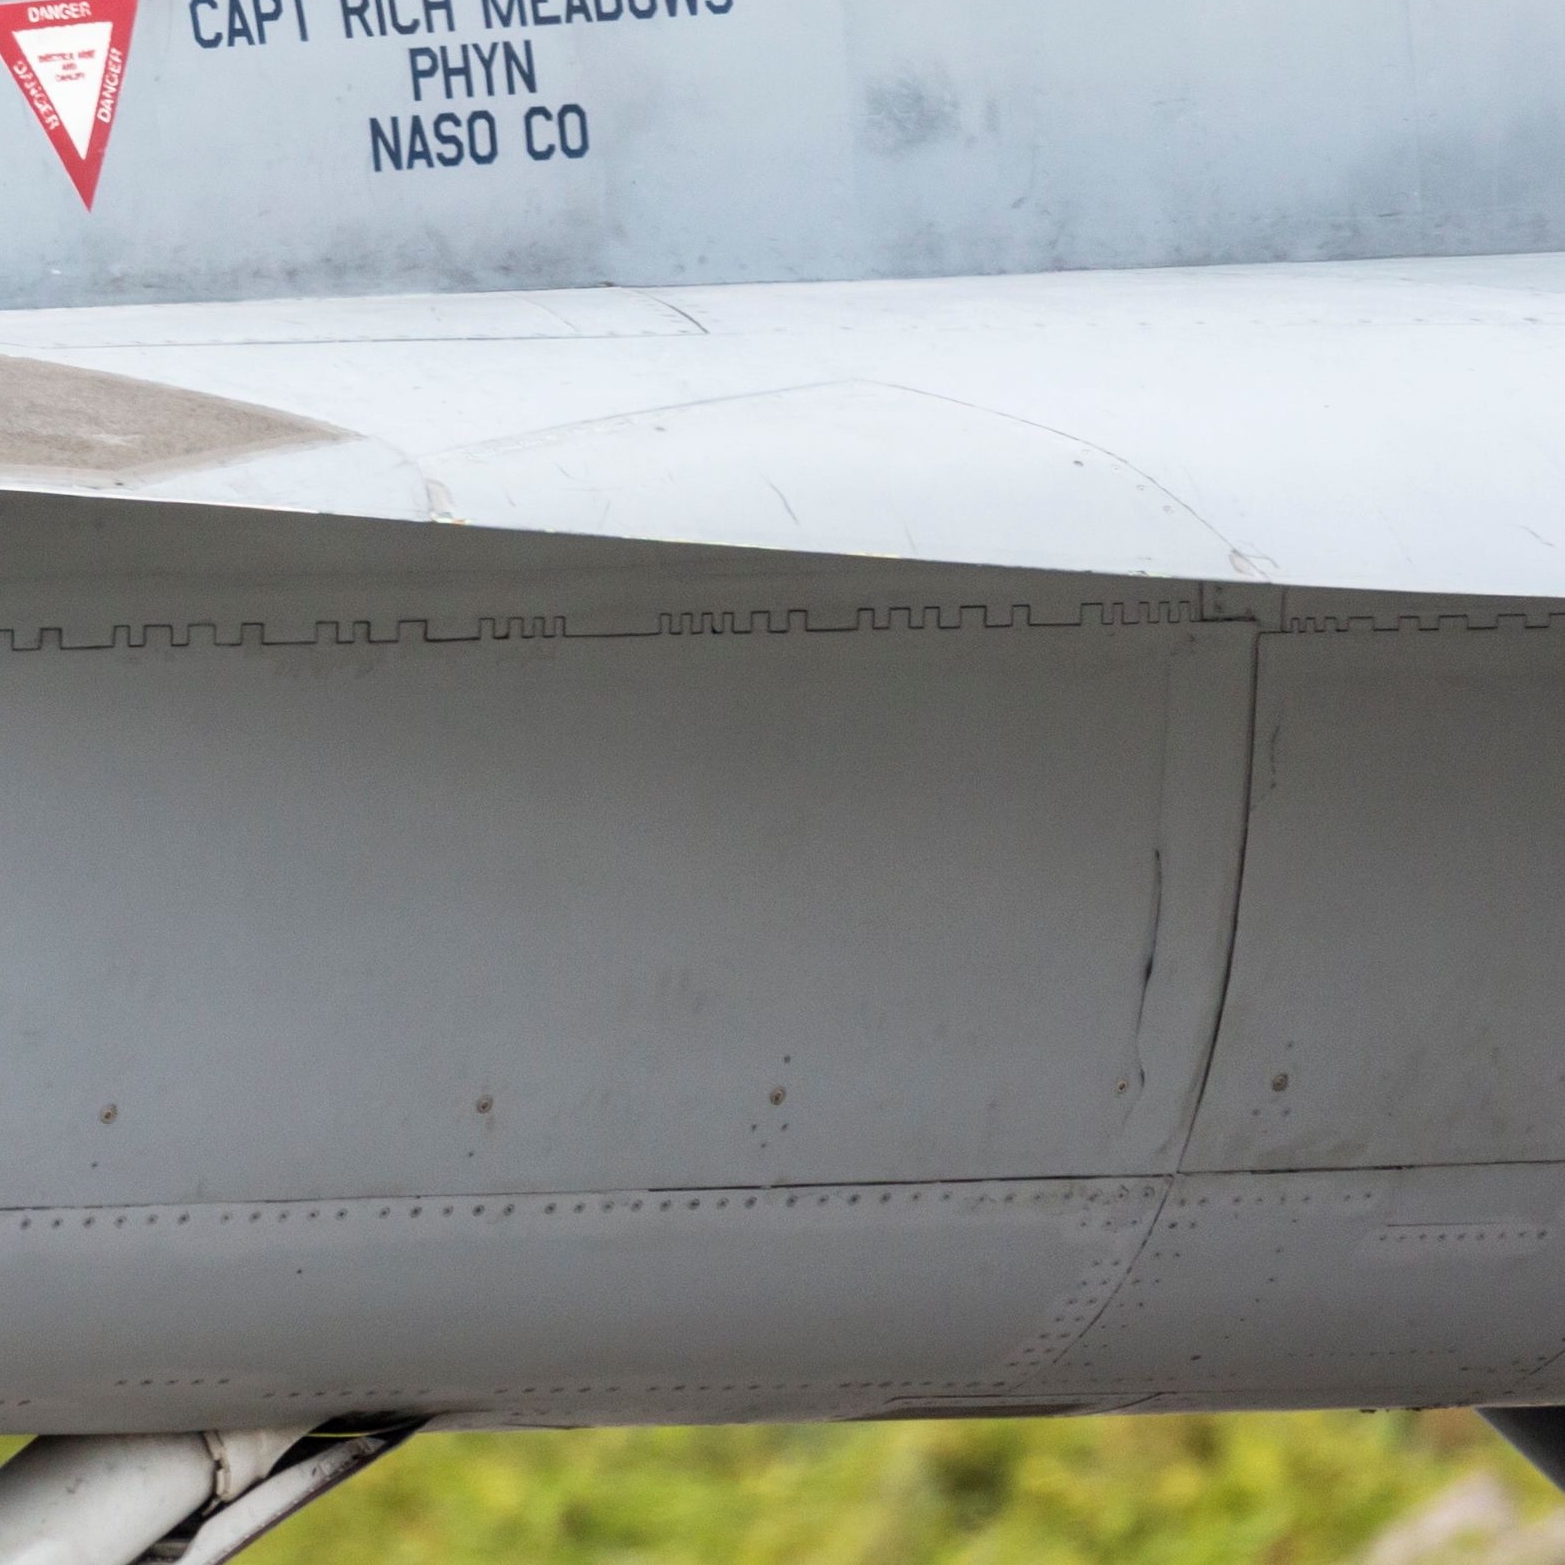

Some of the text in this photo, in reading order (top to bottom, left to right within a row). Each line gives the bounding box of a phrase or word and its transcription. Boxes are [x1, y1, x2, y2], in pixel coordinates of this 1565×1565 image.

[27, 1, 92, 23] DANGER
[97, 47, 123, 124] DANGER
[408, 39, 538, 101] PHYN
[369, 103, 590, 172] NASO CO
